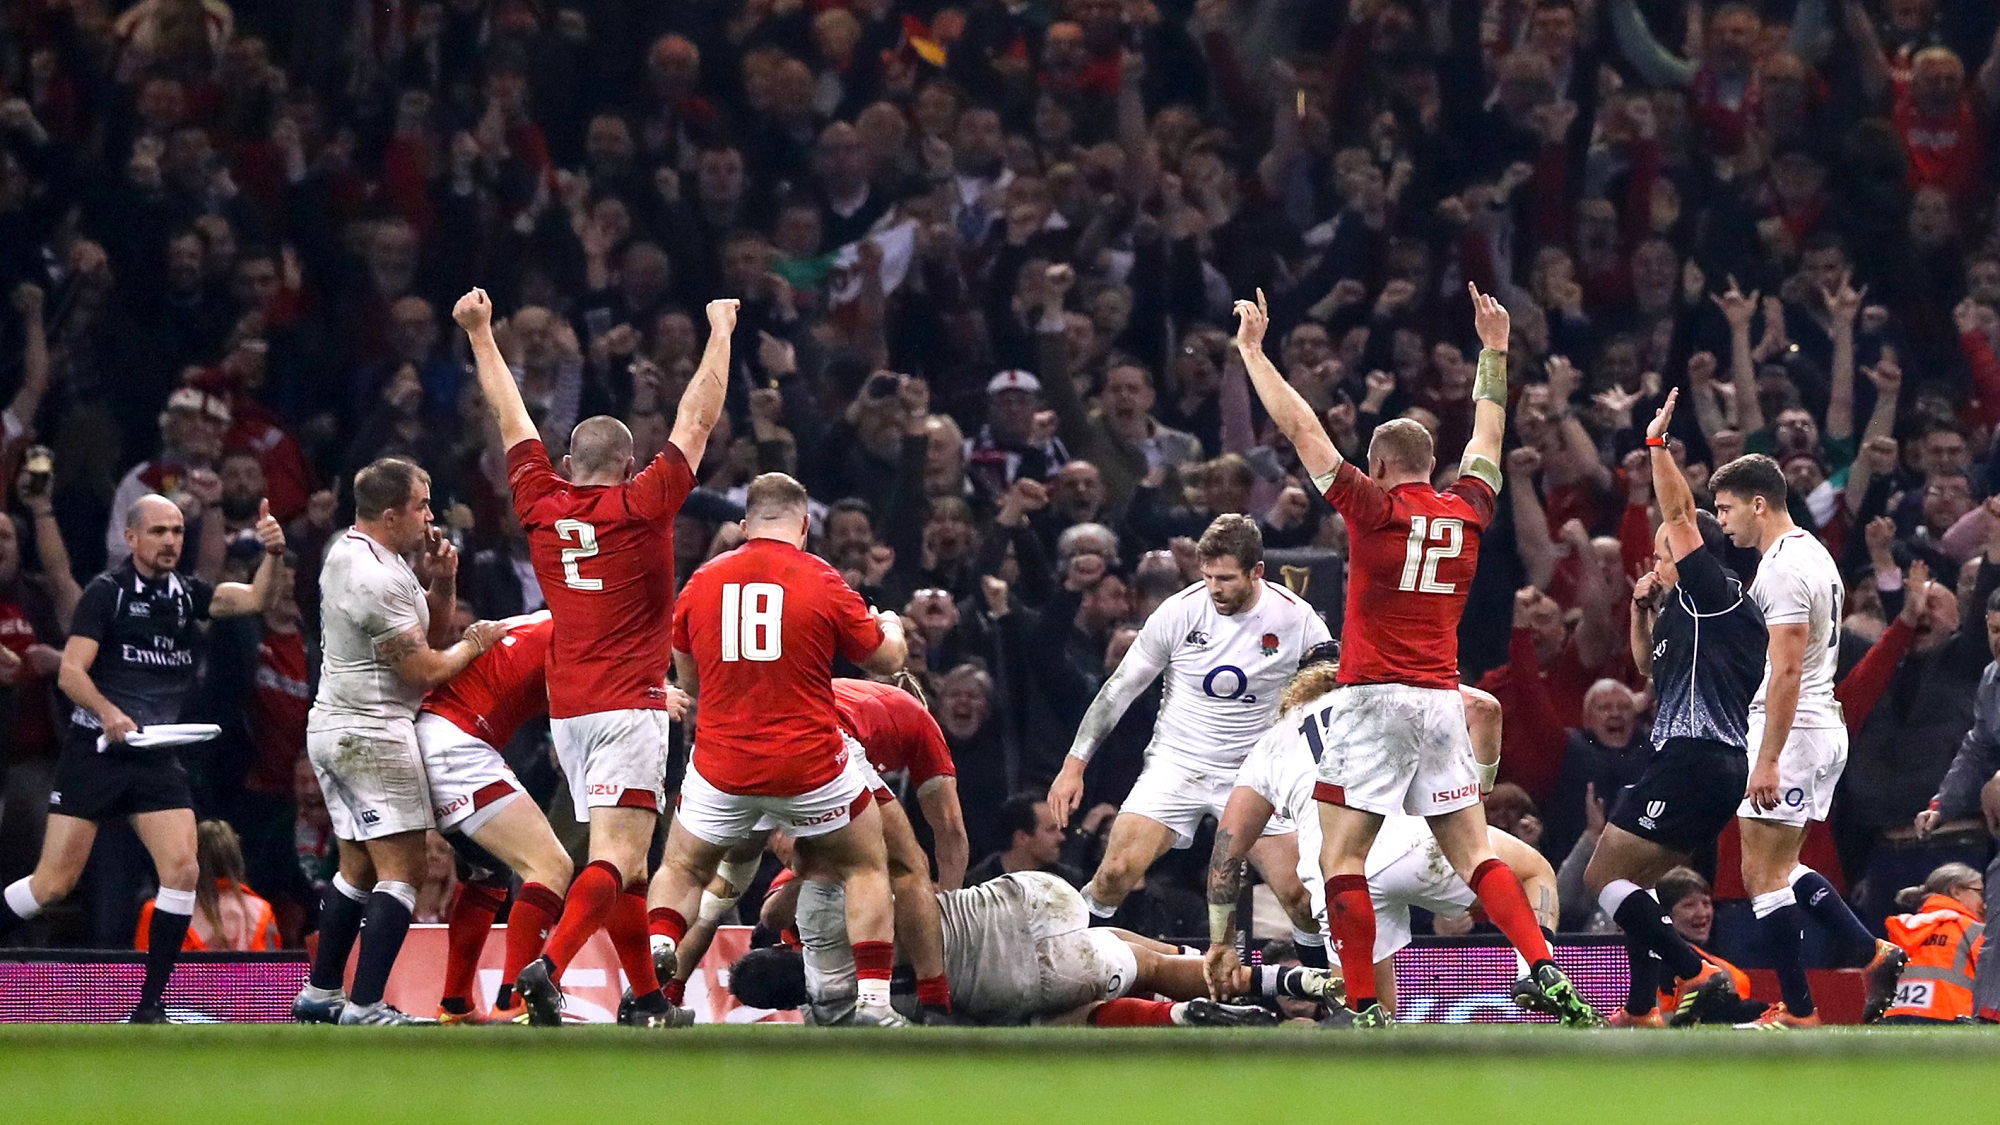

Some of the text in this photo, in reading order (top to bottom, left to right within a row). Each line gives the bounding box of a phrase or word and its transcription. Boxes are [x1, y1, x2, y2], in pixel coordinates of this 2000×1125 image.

[554, 519, 603, 591] 2
[1399, 516, 1464, 594] 12
[721, 582, 784, 662] 18
[154, 634, 175, 651] Fly
[1432, 783, 1478, 803] ISUZU
[433, 794, 470, 821] SUZU
[791, 805, 847, 827] ISUZU
[1897, 985, 1928, 1005] 42
